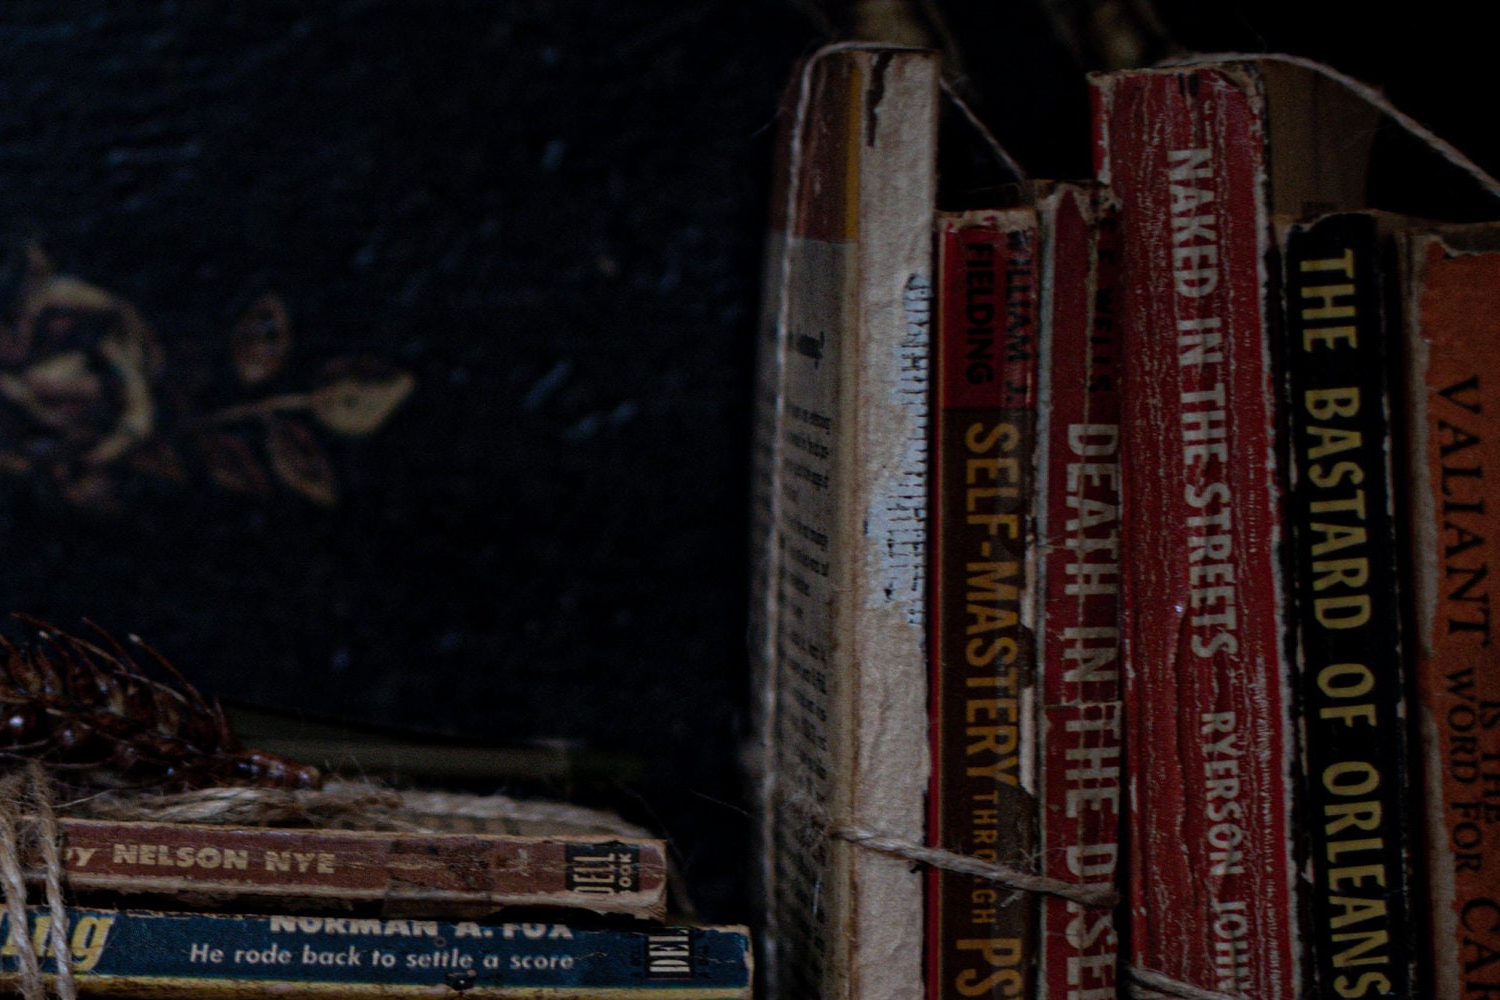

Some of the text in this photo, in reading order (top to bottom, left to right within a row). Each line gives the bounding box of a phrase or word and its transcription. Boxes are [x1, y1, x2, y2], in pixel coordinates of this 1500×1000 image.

[967, 244, 993, 384] FIELDING
[1167, 147, 1238, 660] NAKED IN THE STREETS
[1064, 423, 1121, 596] DEATH
[1438, 376, 1491, 647] VALIANT
[964, 421, 1020, 788] SELF-MASTERY
[1063, 626, 1120, 682] IN
[1300, 249, 1394, 1000] THE BASTARD OF ORLEANS
[1065, 699, 1122, 818] THE
[1202, 711, 1245, 875] RYERSON
[1446, 668, 1483, 872] WORD FOR
[113, 843, 248, 870] NELSON
[265, 851, 336, 875] NYE
[618, 853, 632, 893] OOK
[971, 790, 998, 924] THROGH
[189, 943, 575, 973] He rode back to settle a score
[648, 928, 690, 974] DEL
